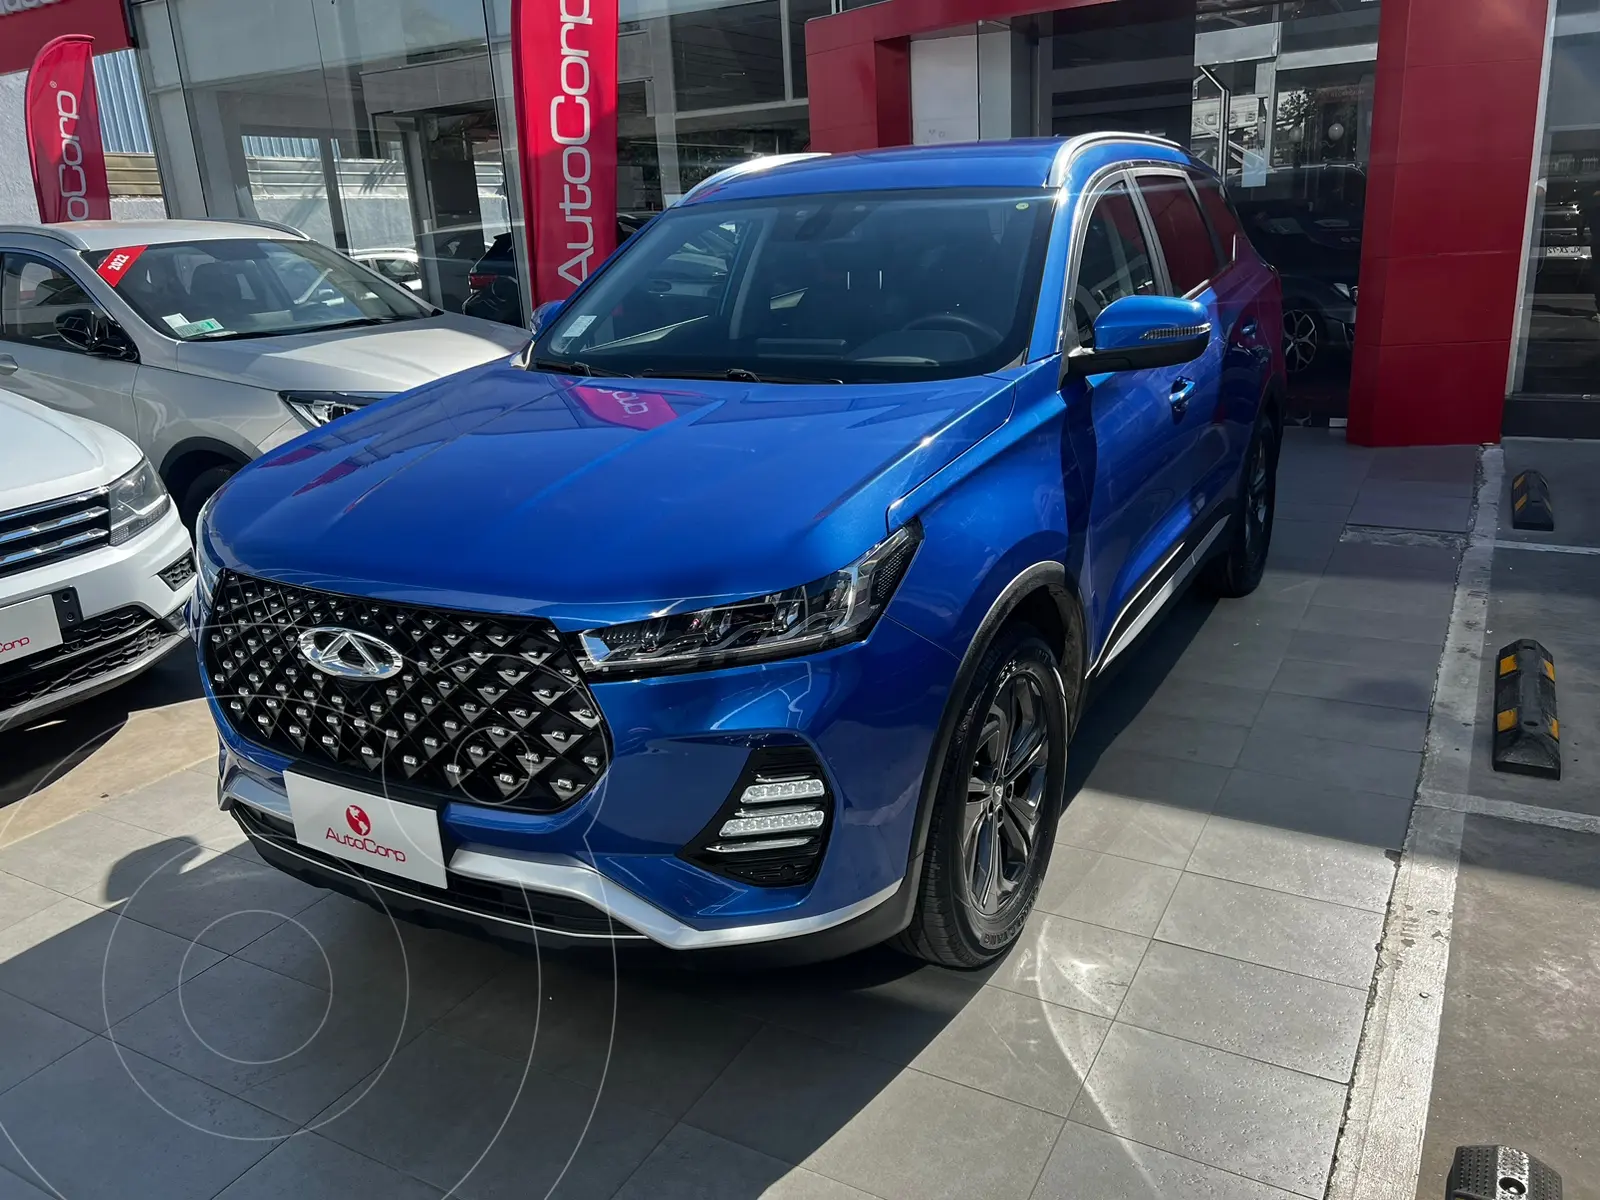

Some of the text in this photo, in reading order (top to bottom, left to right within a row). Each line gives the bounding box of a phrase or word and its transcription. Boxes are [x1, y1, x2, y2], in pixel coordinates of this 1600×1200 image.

[550, 0, 594, 287] AutoCorp
[108, 253, 130, 271] 2022
[325, 827, 407, 862] AutoCorp
